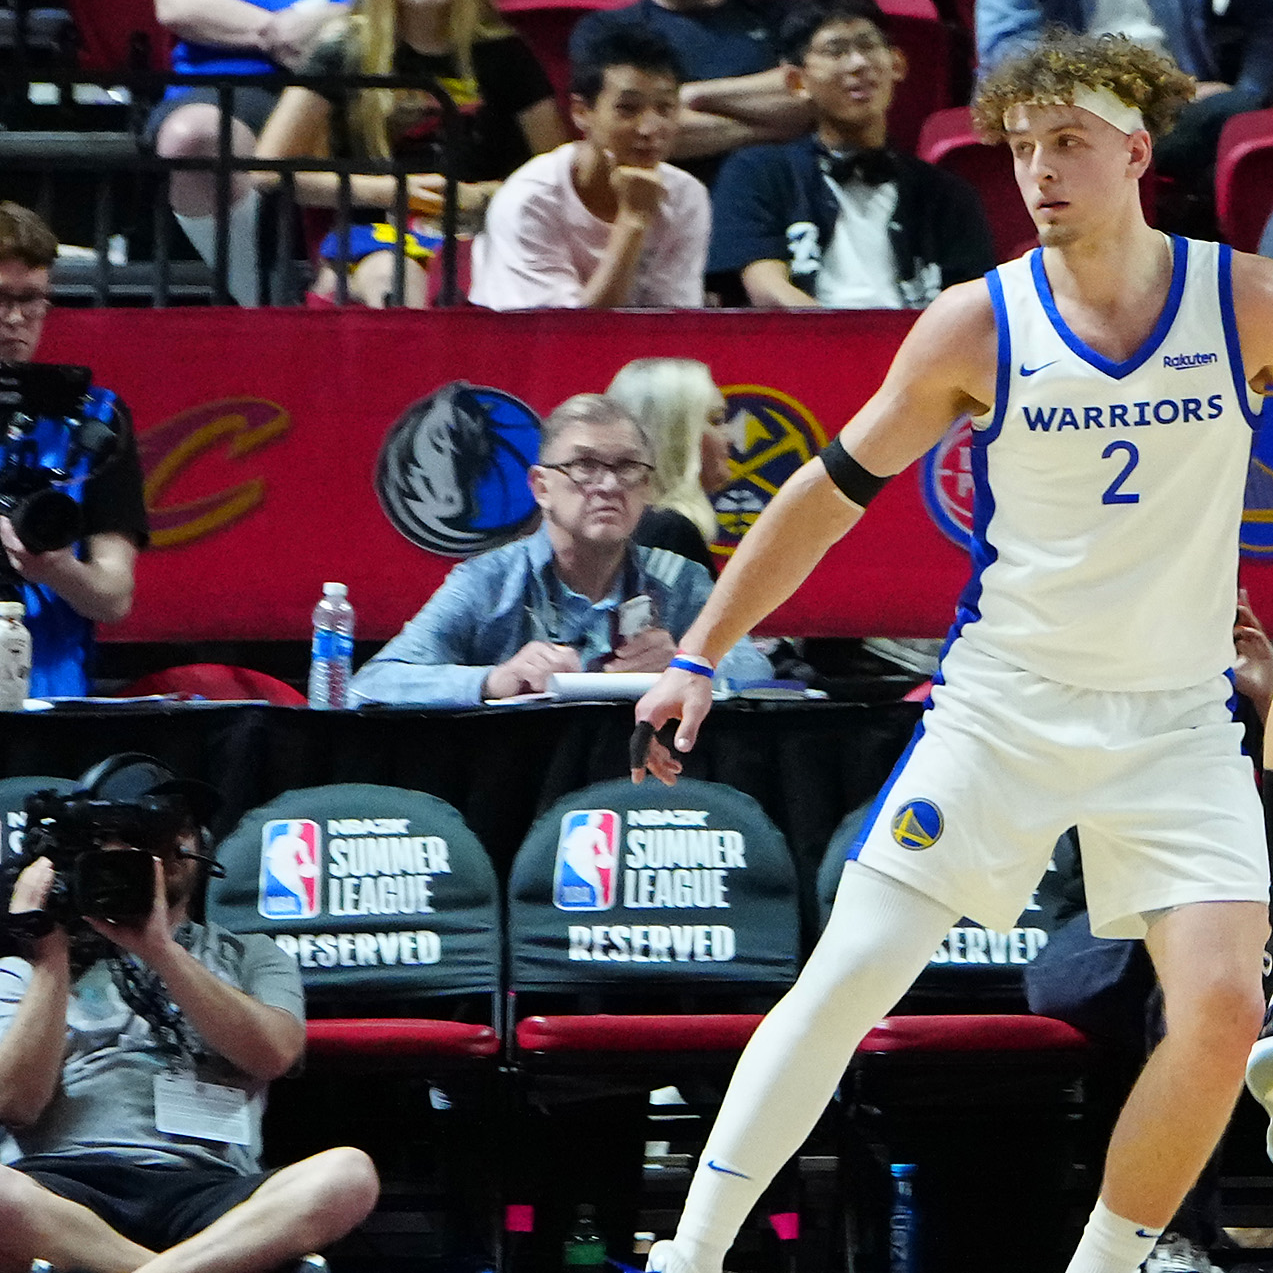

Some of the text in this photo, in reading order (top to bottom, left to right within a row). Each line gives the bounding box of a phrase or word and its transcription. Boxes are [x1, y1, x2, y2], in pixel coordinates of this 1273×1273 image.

[1163, 352, 1218, 370] Rakuten
[1021, 394, 1224, 433] WARRIORS
[1101, 440, 1140, 505] 2
[328, 835, 452, 877] SUMMER
[626, 829, 748, 869] SUMMER
[328, 875, 436, 916] LEAGUE
[623, 869, 731, 909] LEAGUE
[568, 925, 737, 963] RESERVED
